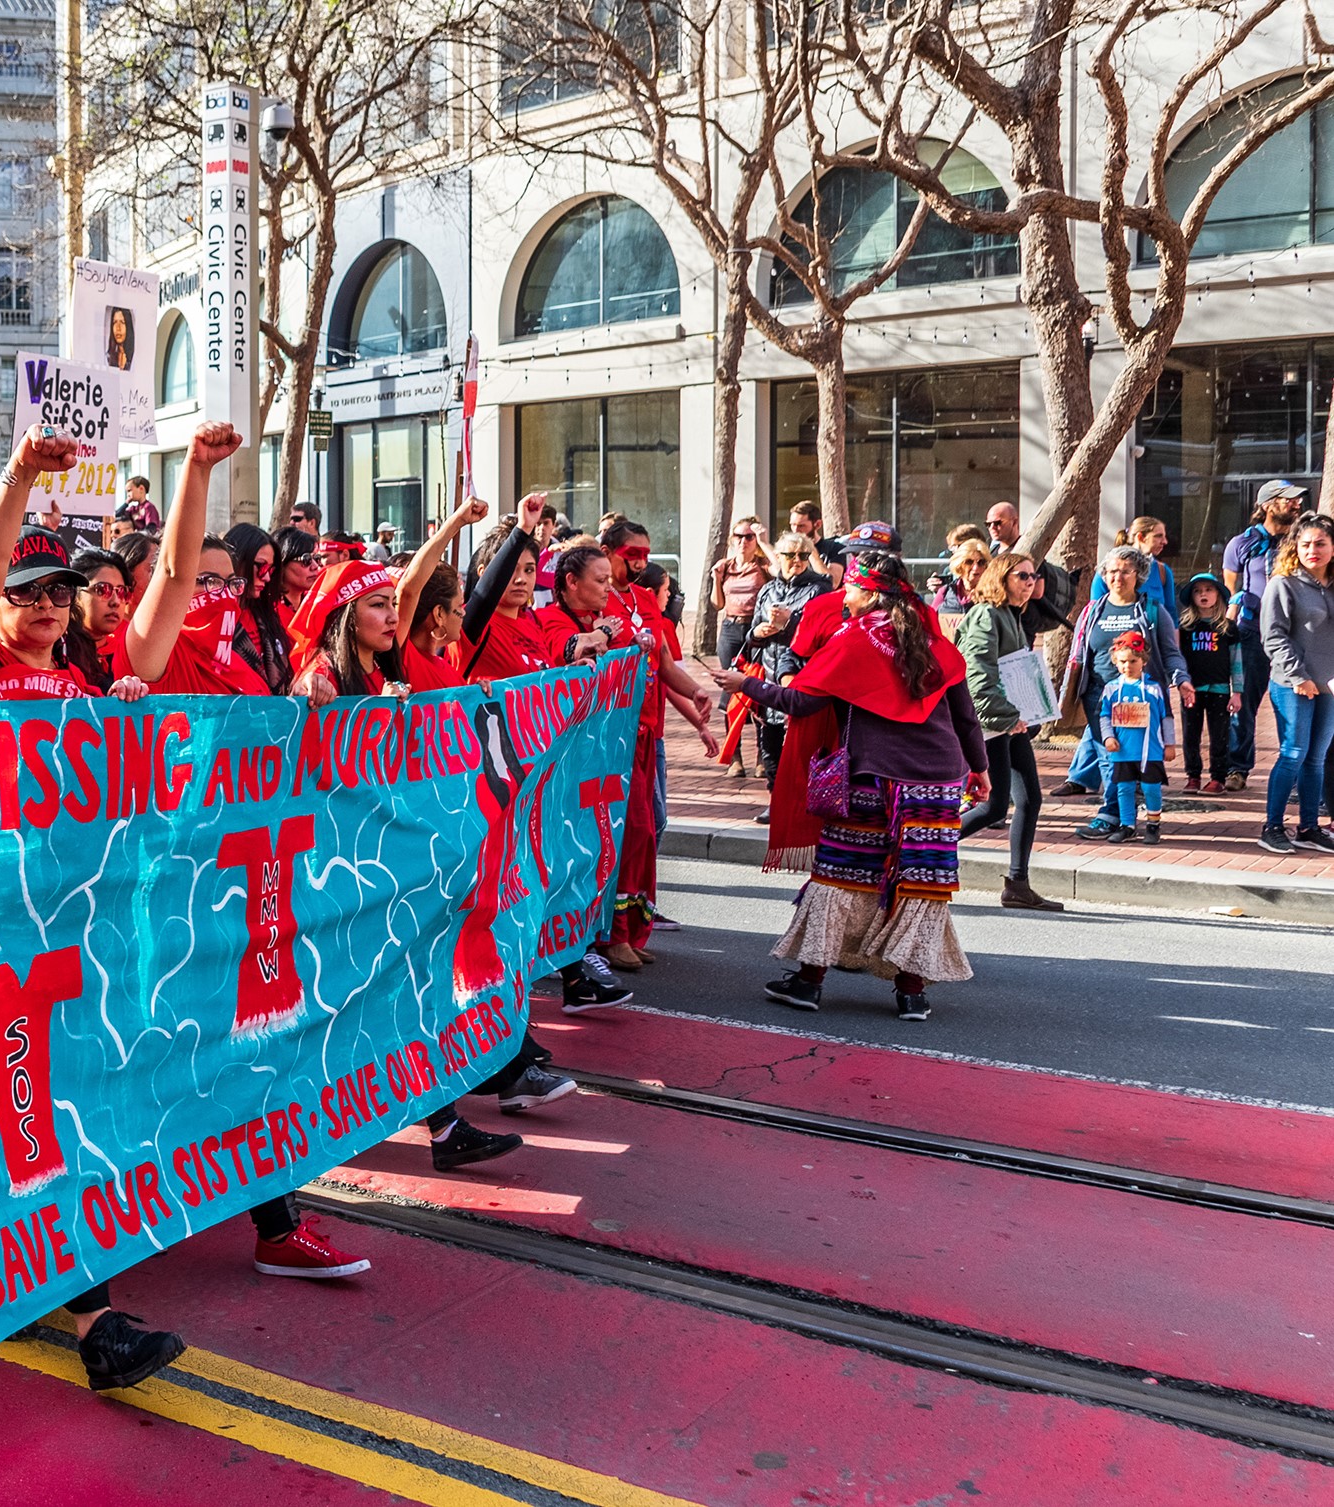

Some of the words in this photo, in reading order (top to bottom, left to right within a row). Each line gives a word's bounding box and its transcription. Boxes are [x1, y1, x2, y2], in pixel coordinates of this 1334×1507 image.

[208, 224, 224, 281] Civic
[234, 223, 247, 280] Civic
[208, 291, 224, 372] Center
[234, 290, 247, 372] Center
[25, 360, 105, 407] Valerie
[341, 396, 371, 406] UNITED
[374, 389, 411, 400] NATIONS
[415, 386, 443, 396] PLAZA
[75, 439, 97, 457] ince
[76, 461, 117, 496] 2012
[72, 518, 103, 531] RESISTANC
[11, 536, 67, 566] NAVAJO
[1192, 632, 1218, 641] LOVE
[1192, 642, 1218, 651] WINS
[24, 676, 63, 696] MORE
[203, 745, 282, 807] AND
[292, 699, 482, 797] MURDERED
[256, 860, 280, 984] MMIW
[4, 1016, 39, 1162] SOS
[81, 1161, 173, 1250] OUR
[172, 1101, 309, 1207] SISTERS
[321, 1062, 390, 1139] SAVE
[385, 1040, 437, 1101] OUR
[439, 995, 512, 1076] SISTERS
